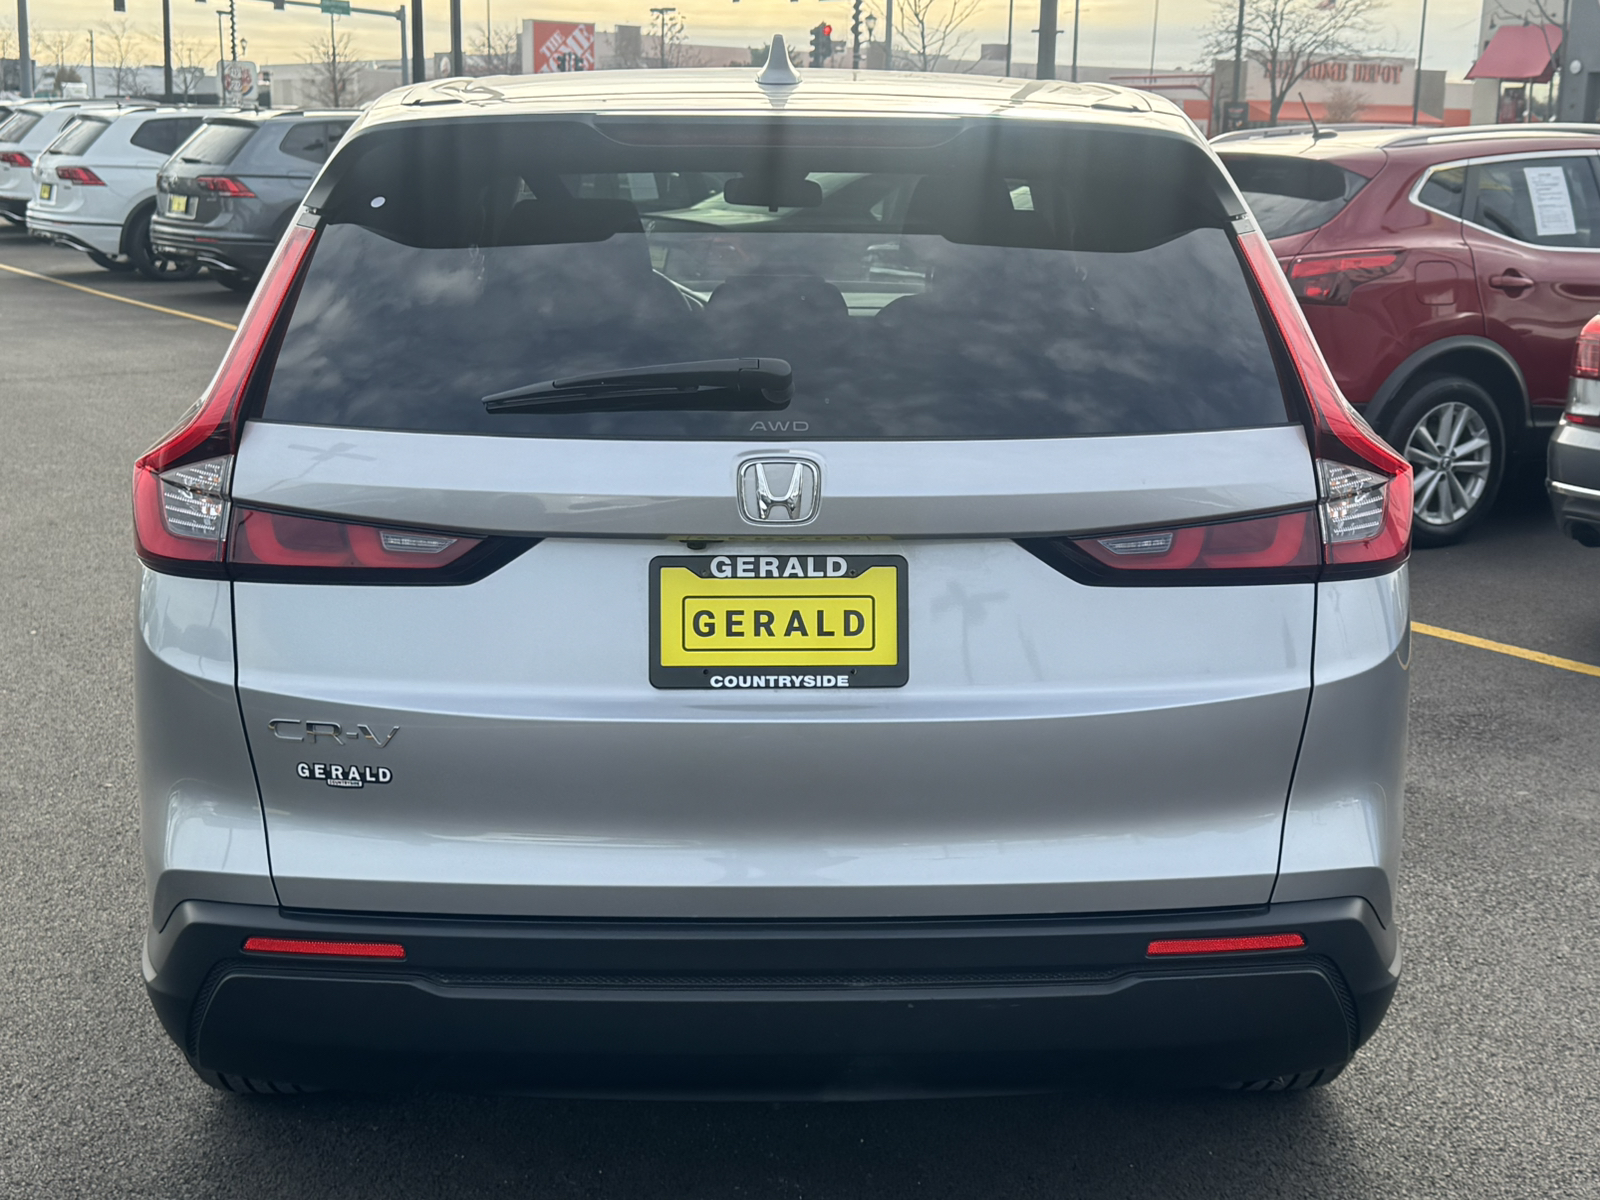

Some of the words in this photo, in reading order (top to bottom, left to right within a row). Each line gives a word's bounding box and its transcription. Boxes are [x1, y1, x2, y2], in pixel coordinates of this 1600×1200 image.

[539, 29, 566, 57] THE
[1352, 63, 1404, 85] DEPOT
[749, 421, 810, 432] AWD
[710, 556, 848, 578] GERALD
[692, 609, 866, 638] GERALD
[709, 675, 850, 688] COUNTRYSIDE
[268, 717, 401, 748] CR-V
[297, 763, 392, 783] GERALD
